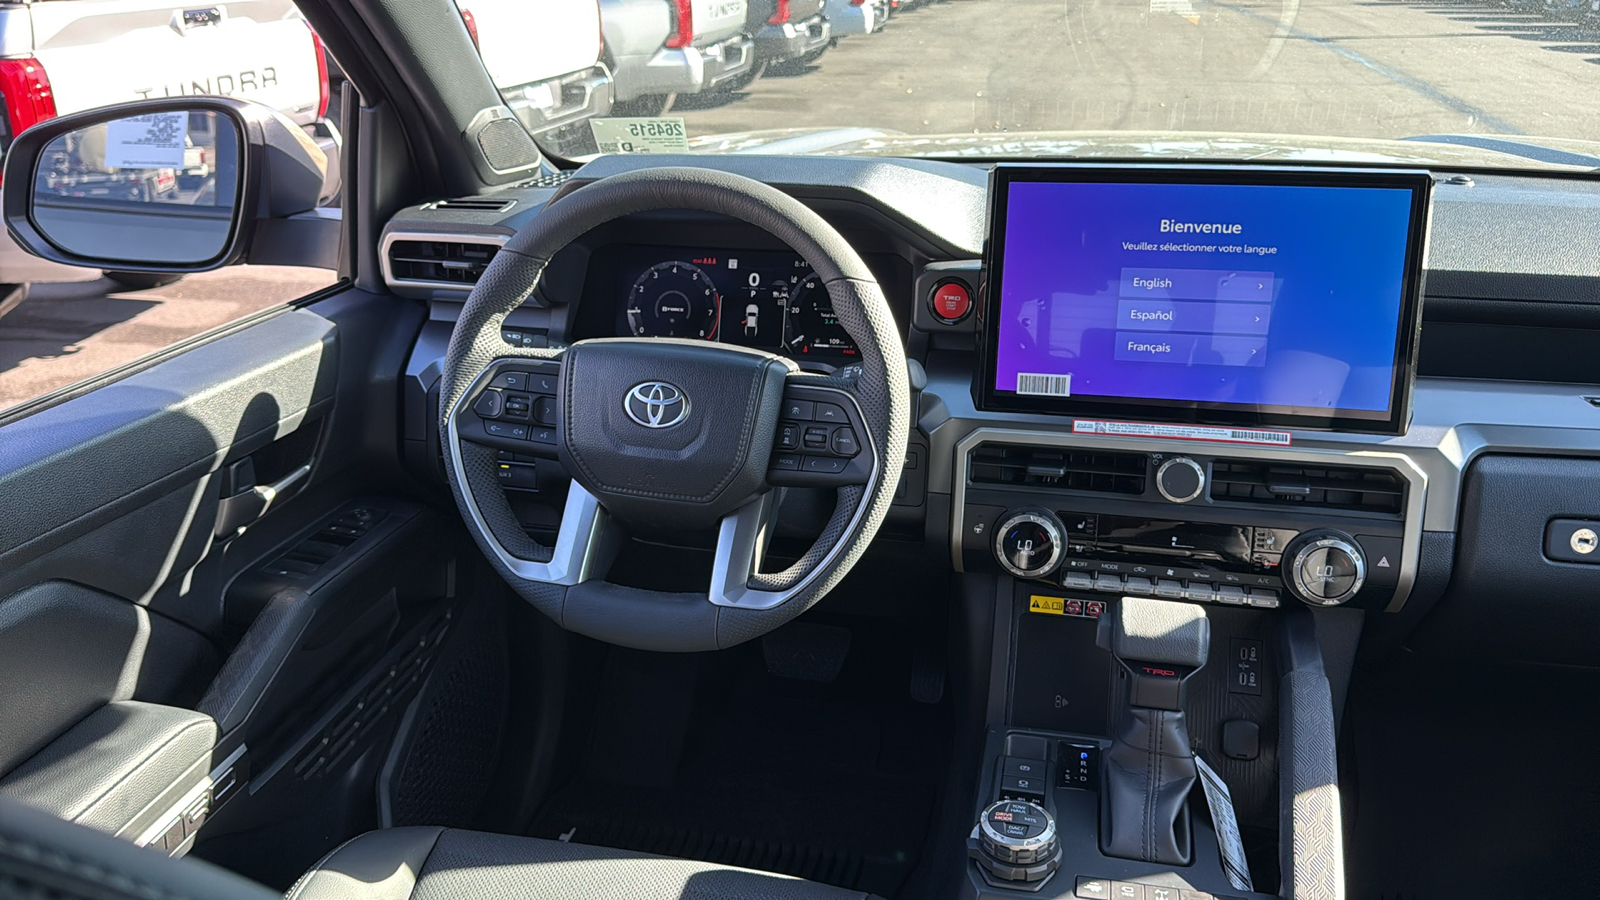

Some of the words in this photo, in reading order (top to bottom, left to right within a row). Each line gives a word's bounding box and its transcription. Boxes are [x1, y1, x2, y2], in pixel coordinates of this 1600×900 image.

[133, 66, 278, 100] TUNDRA
[1159, 218, 1243, 235] Bienvenue
[1122, 241, 1158, 252] Veuillez
[1159, 242, 1217, 254] sélectionner
[1218, 245, 1242, 254] votre
[1243, 244, 1278, 256] langue
[672, 266, 678, 274] 4
[748, 272, 760, 287] 0
[1132, 277, 1173, 290] English
[639, 285, 645, 293] 2
[704, 288, 711, 296] 6
[750, 290, 757, 298] P
[790, 306, 800, 314] 20
[1130, 309, 1174, 322] Español
[639, 326, 645, 334] 0
[1127, 341, 1172, 355] Français
[1101, 563, 1119, 571] MODE
[1257, 577, 1270, 585] A/C
[1142, 666, 1175, 676] TRD
